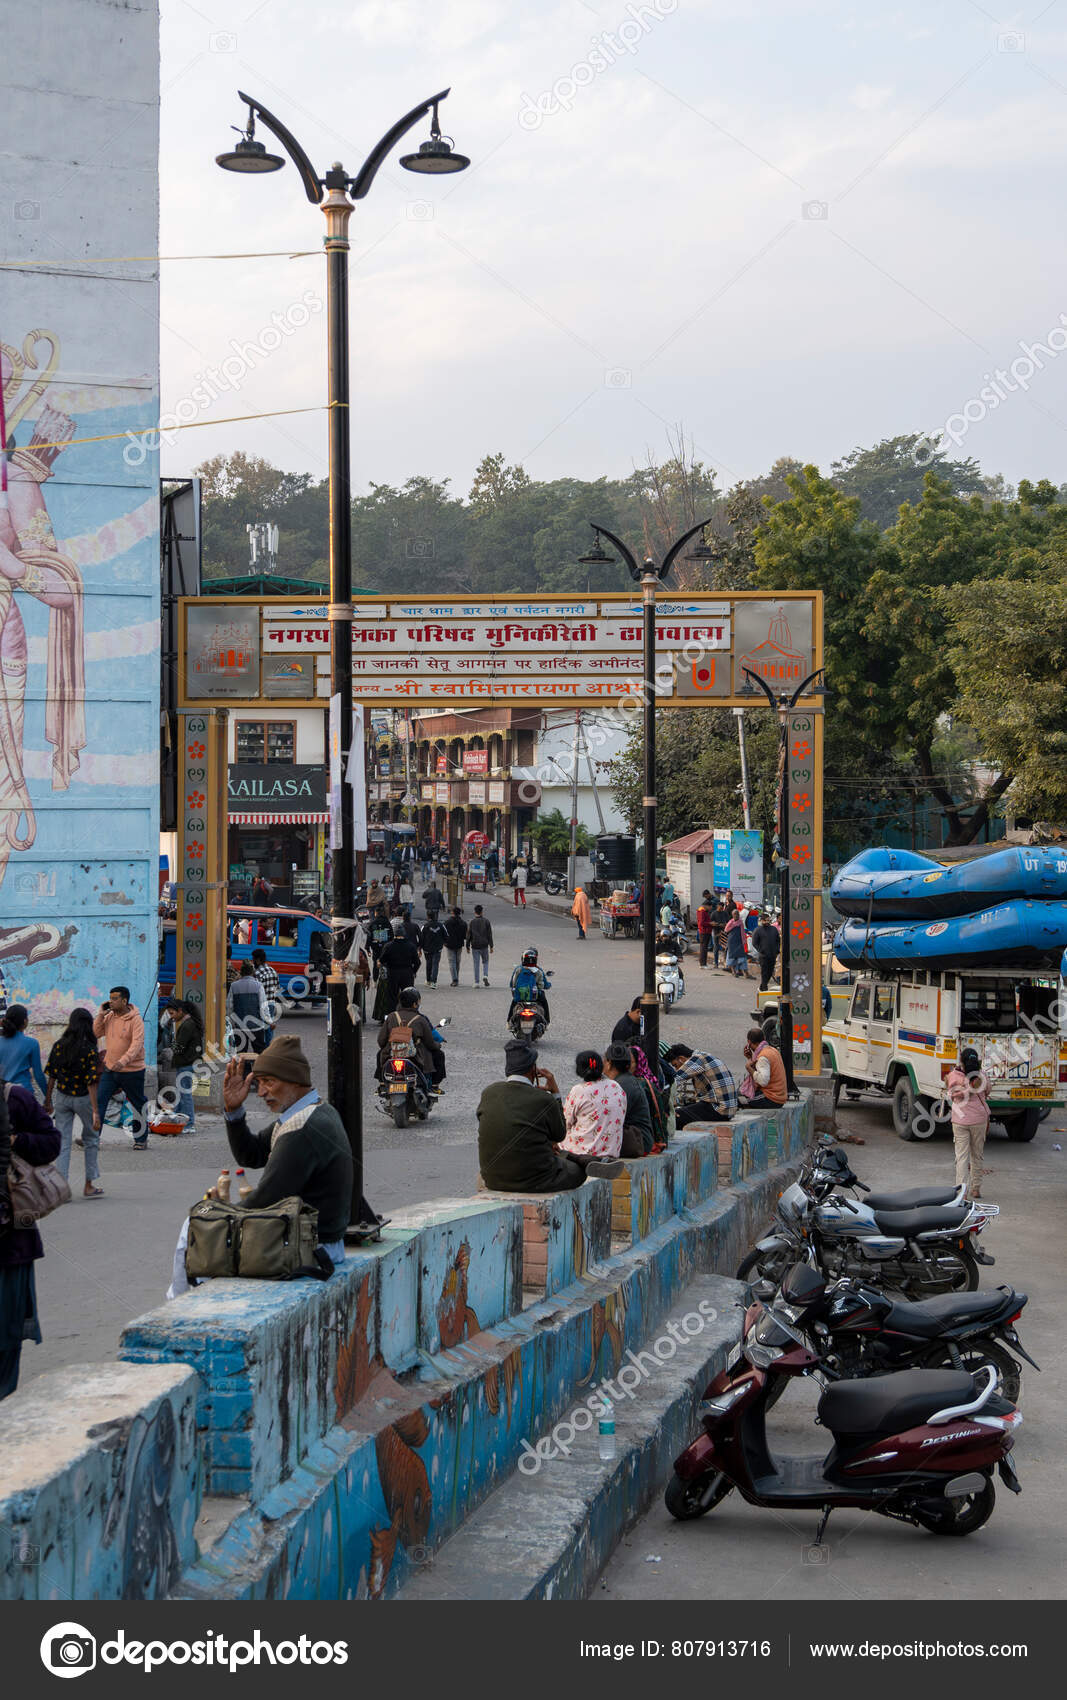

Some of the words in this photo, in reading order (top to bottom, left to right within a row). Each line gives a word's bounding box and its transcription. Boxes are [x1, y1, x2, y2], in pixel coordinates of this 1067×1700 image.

[401, 607, 423, 615] चार
[429, 607, 454, 615] धाम
[489, 605, 508, 616] एवं
[514, 604, 550, 615] पर्यटन
[555, 604, 585, 614] नगरी
[407, 624, 476, 642] परिषद
[485, 623, 598, 647] मुनिकीरेती
[371, 657, 419, 669] जानकी
[425, 656, 452, 672] सेतू
[457, 659, 507, 669] आगमन
[514, 659, 532, 669] पर
[537, 657, 583, 669] हार्दिक
[429, 680, 581, 695] स्वामिनारायण
[1024, 859, 1039, 872] UT
